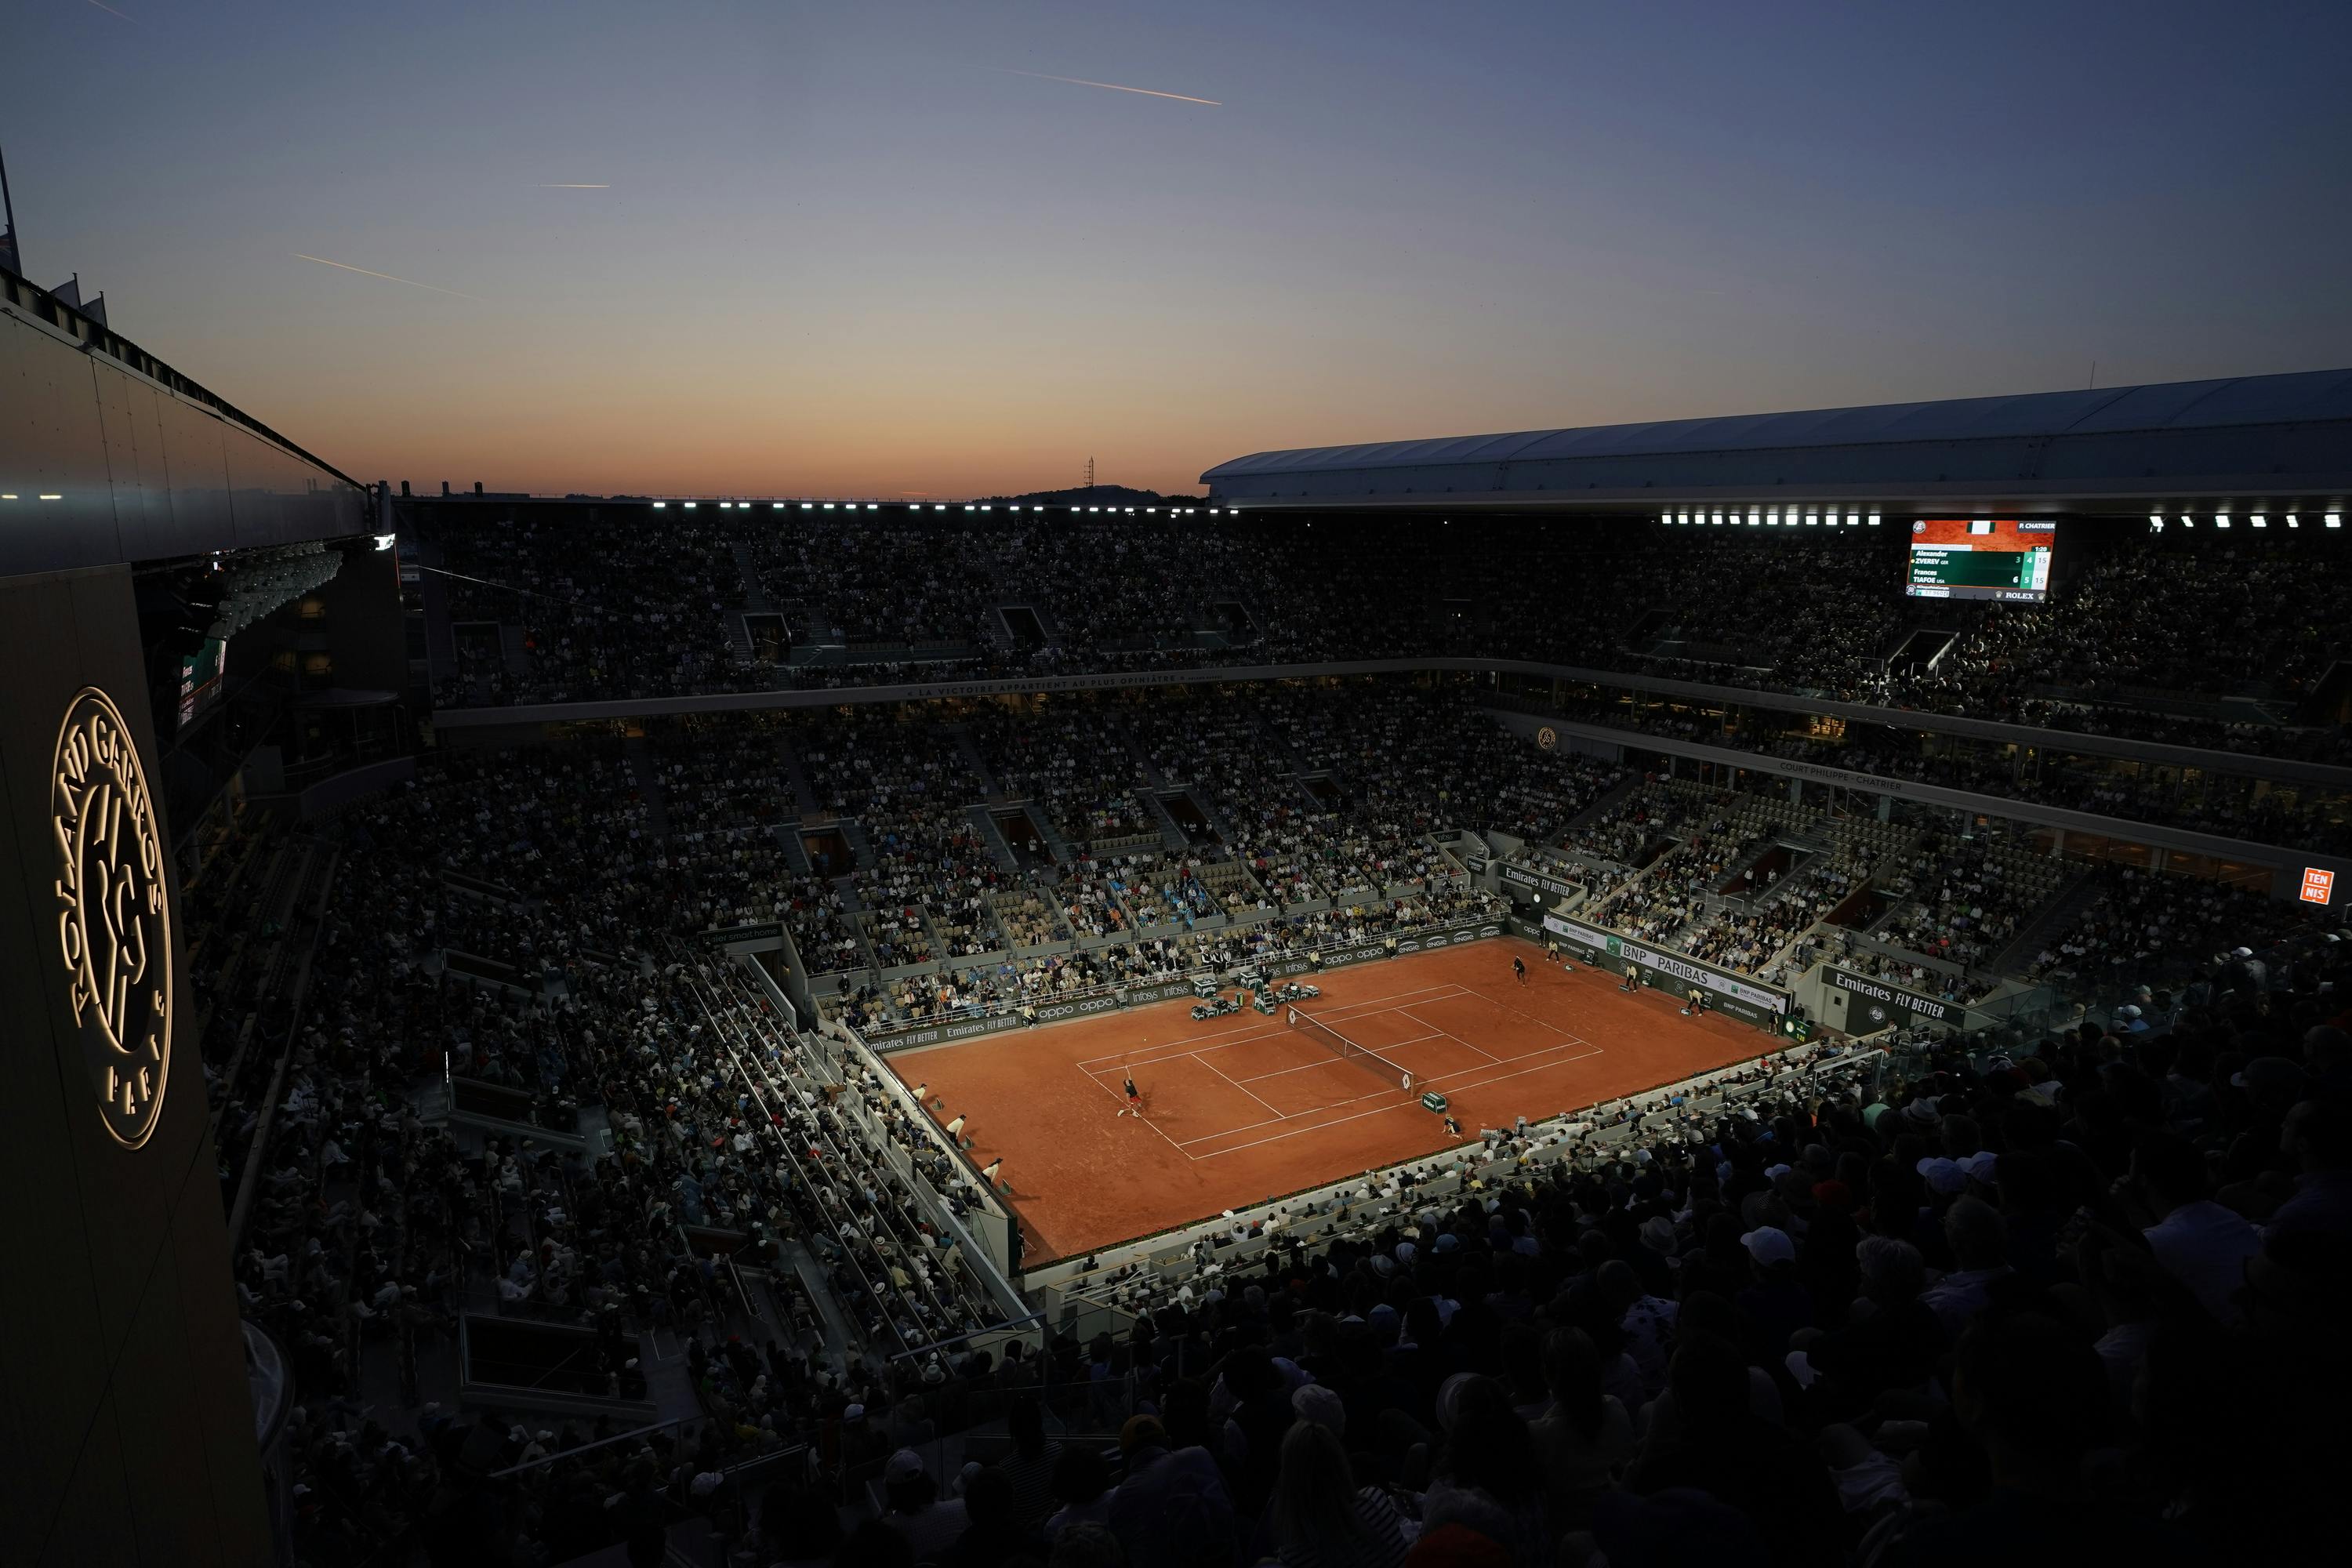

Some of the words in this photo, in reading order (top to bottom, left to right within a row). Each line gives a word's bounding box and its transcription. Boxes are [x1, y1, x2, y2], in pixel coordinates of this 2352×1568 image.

[938, 685, 993, 695] VICTOIRE
[999, 681, 1067, 691] APPARTIENT
[1780, 762, 1808, 773] COURT
[1811, 768, 1849, 781] PHILIPPE
[1856, 776, 1901, 791] CHATRIER
[1505, 867, 1539, 887] Emirates
[1541, 879, 1550, 891] FLY
[1550, 882, 1570, 897] BETTER
[2308, 873, 2328, 885] TEN
[2305, 887, 2325, 899] NIS
[1325, 953, 1352, 966] oppo
[1356, 947, 1384, 960] oppo
[1623, 946, 1646, 962] BNP
[1657, 956, 1708, 985] PARIBAS
[1285, 961, 1308, 975] Infosys
[1132, 990, 1159, 1004] Infosys
[1163, 985, 1189, 998] Infosys
[1751, 990, 1773, 1004] PARIBAS
[1835, 972, 1892, 1002] Emirates
[1895, 993, 1911, 1009] FLY
[1911, 996, 1945, 1018] BETTER
[1039, 1005, 1074, 1019] oppo
[1080, 998, 1114, 1012] oppo
[1735, 1004, 1758, 1018] PARIBAS
[906, 1035, 916, 1045] FLY
[917, 1031, 938, 1043] BETTER
[946, 1024, 985, 1038] Emirates
[987, 1021, 997, 1030] FLY
[997, 1016, 1017, 1028] BETTER
